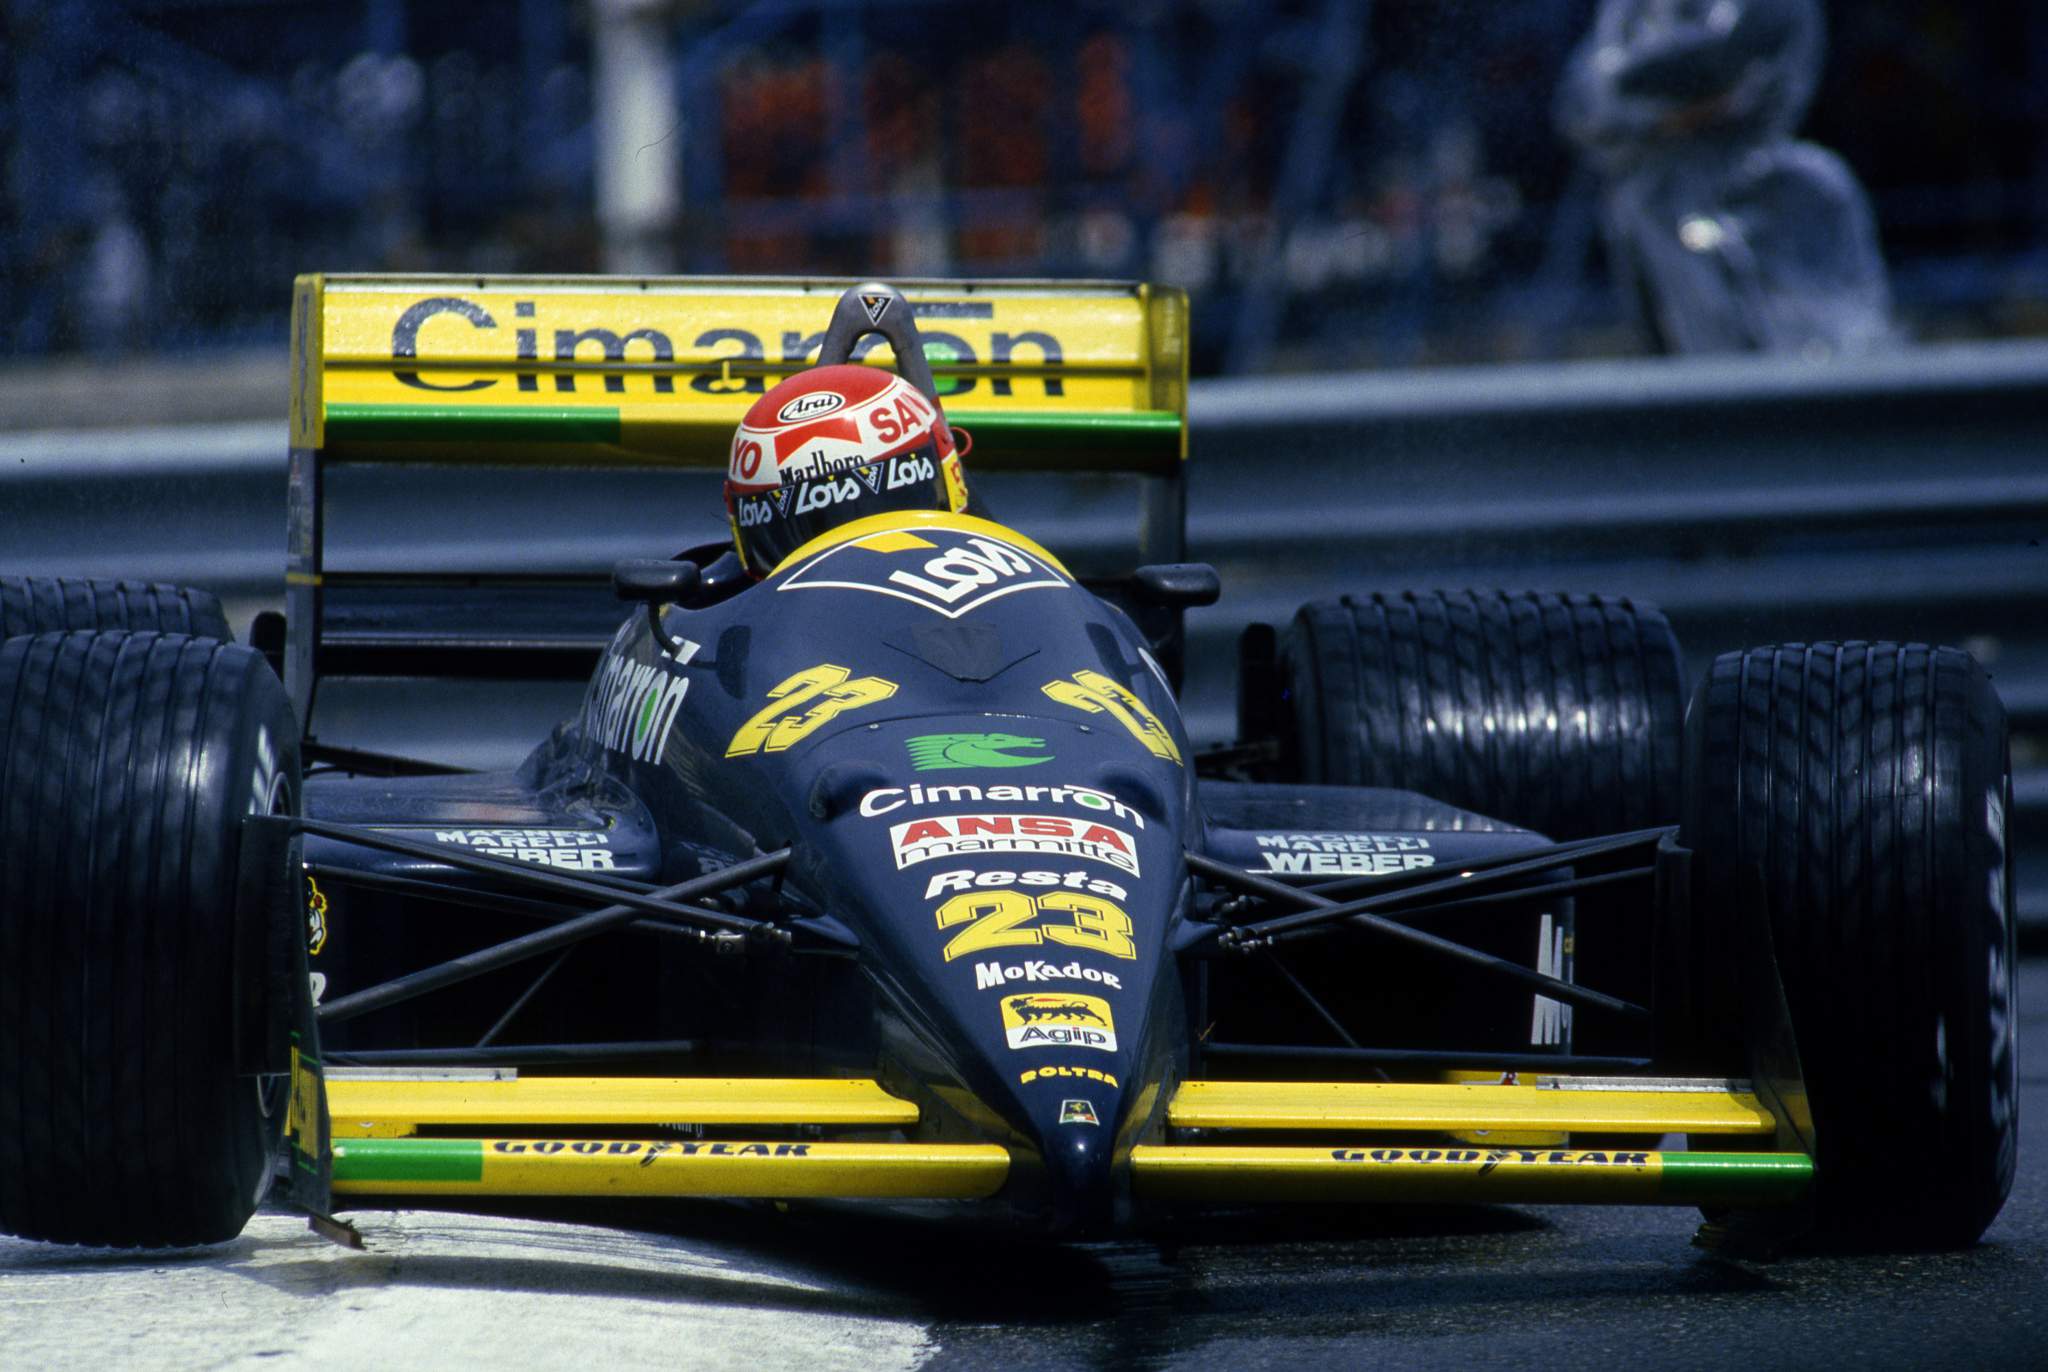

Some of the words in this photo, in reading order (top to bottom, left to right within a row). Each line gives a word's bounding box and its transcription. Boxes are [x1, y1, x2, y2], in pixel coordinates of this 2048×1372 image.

[784, 395, 833, 418] Arai
[779, 451, 865, 485] Marlboro
[725, 664, 900, 758] 23
[859, 784, 1145, 830] Cimarron
[901, 817, 1132, 856] ANSA
[475, 848, 615, 871] BER
[901, 838, 1137, 870] marmitte
[1262, 852, 1436, 875] WEBER
[925, 870, 1128, 901] Resta
[935, 890, 1137, 962] 23
[1020, 1027, 1107, 1045] Agip
[1331, 1148, 1651, 1169] GOODYEAR
